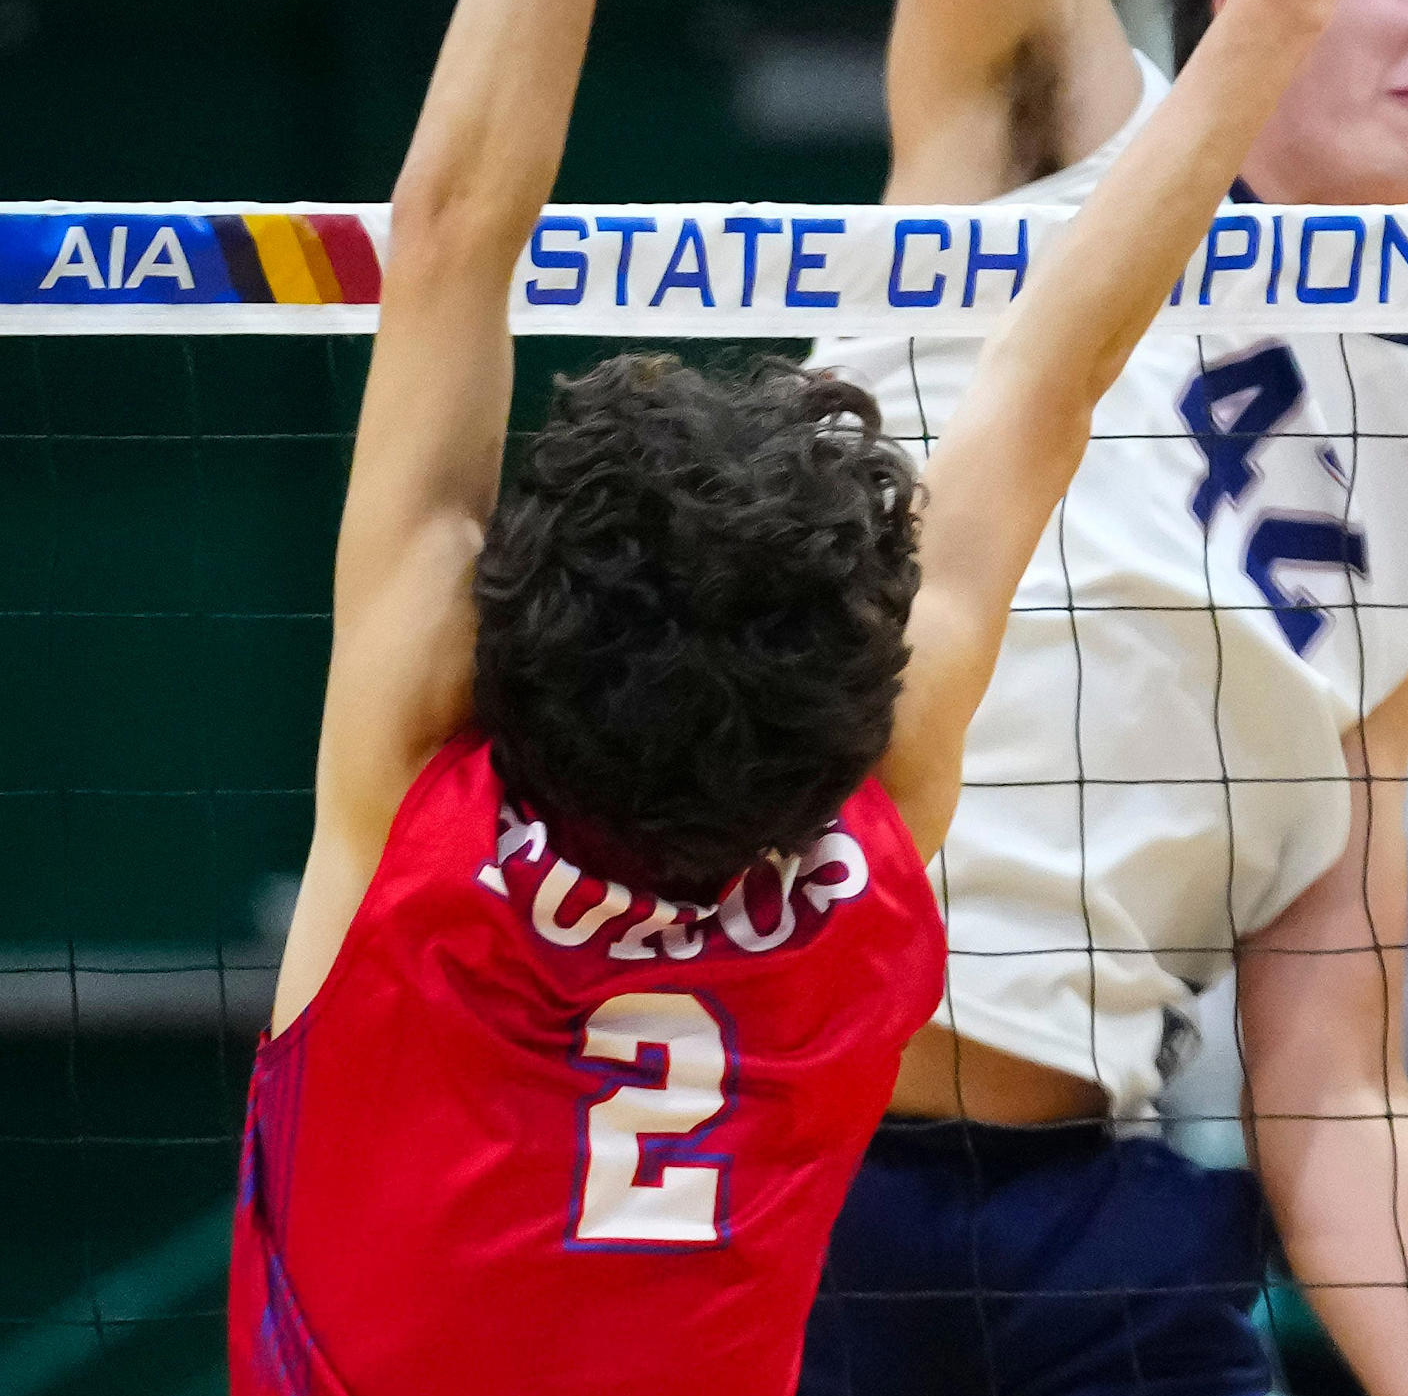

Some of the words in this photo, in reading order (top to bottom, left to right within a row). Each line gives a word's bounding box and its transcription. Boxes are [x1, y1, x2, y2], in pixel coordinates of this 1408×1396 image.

[40, 225, 195, 290] AIA
[526, 215, 846, 308] STATE
[570, 989, 735, 1248] 2
